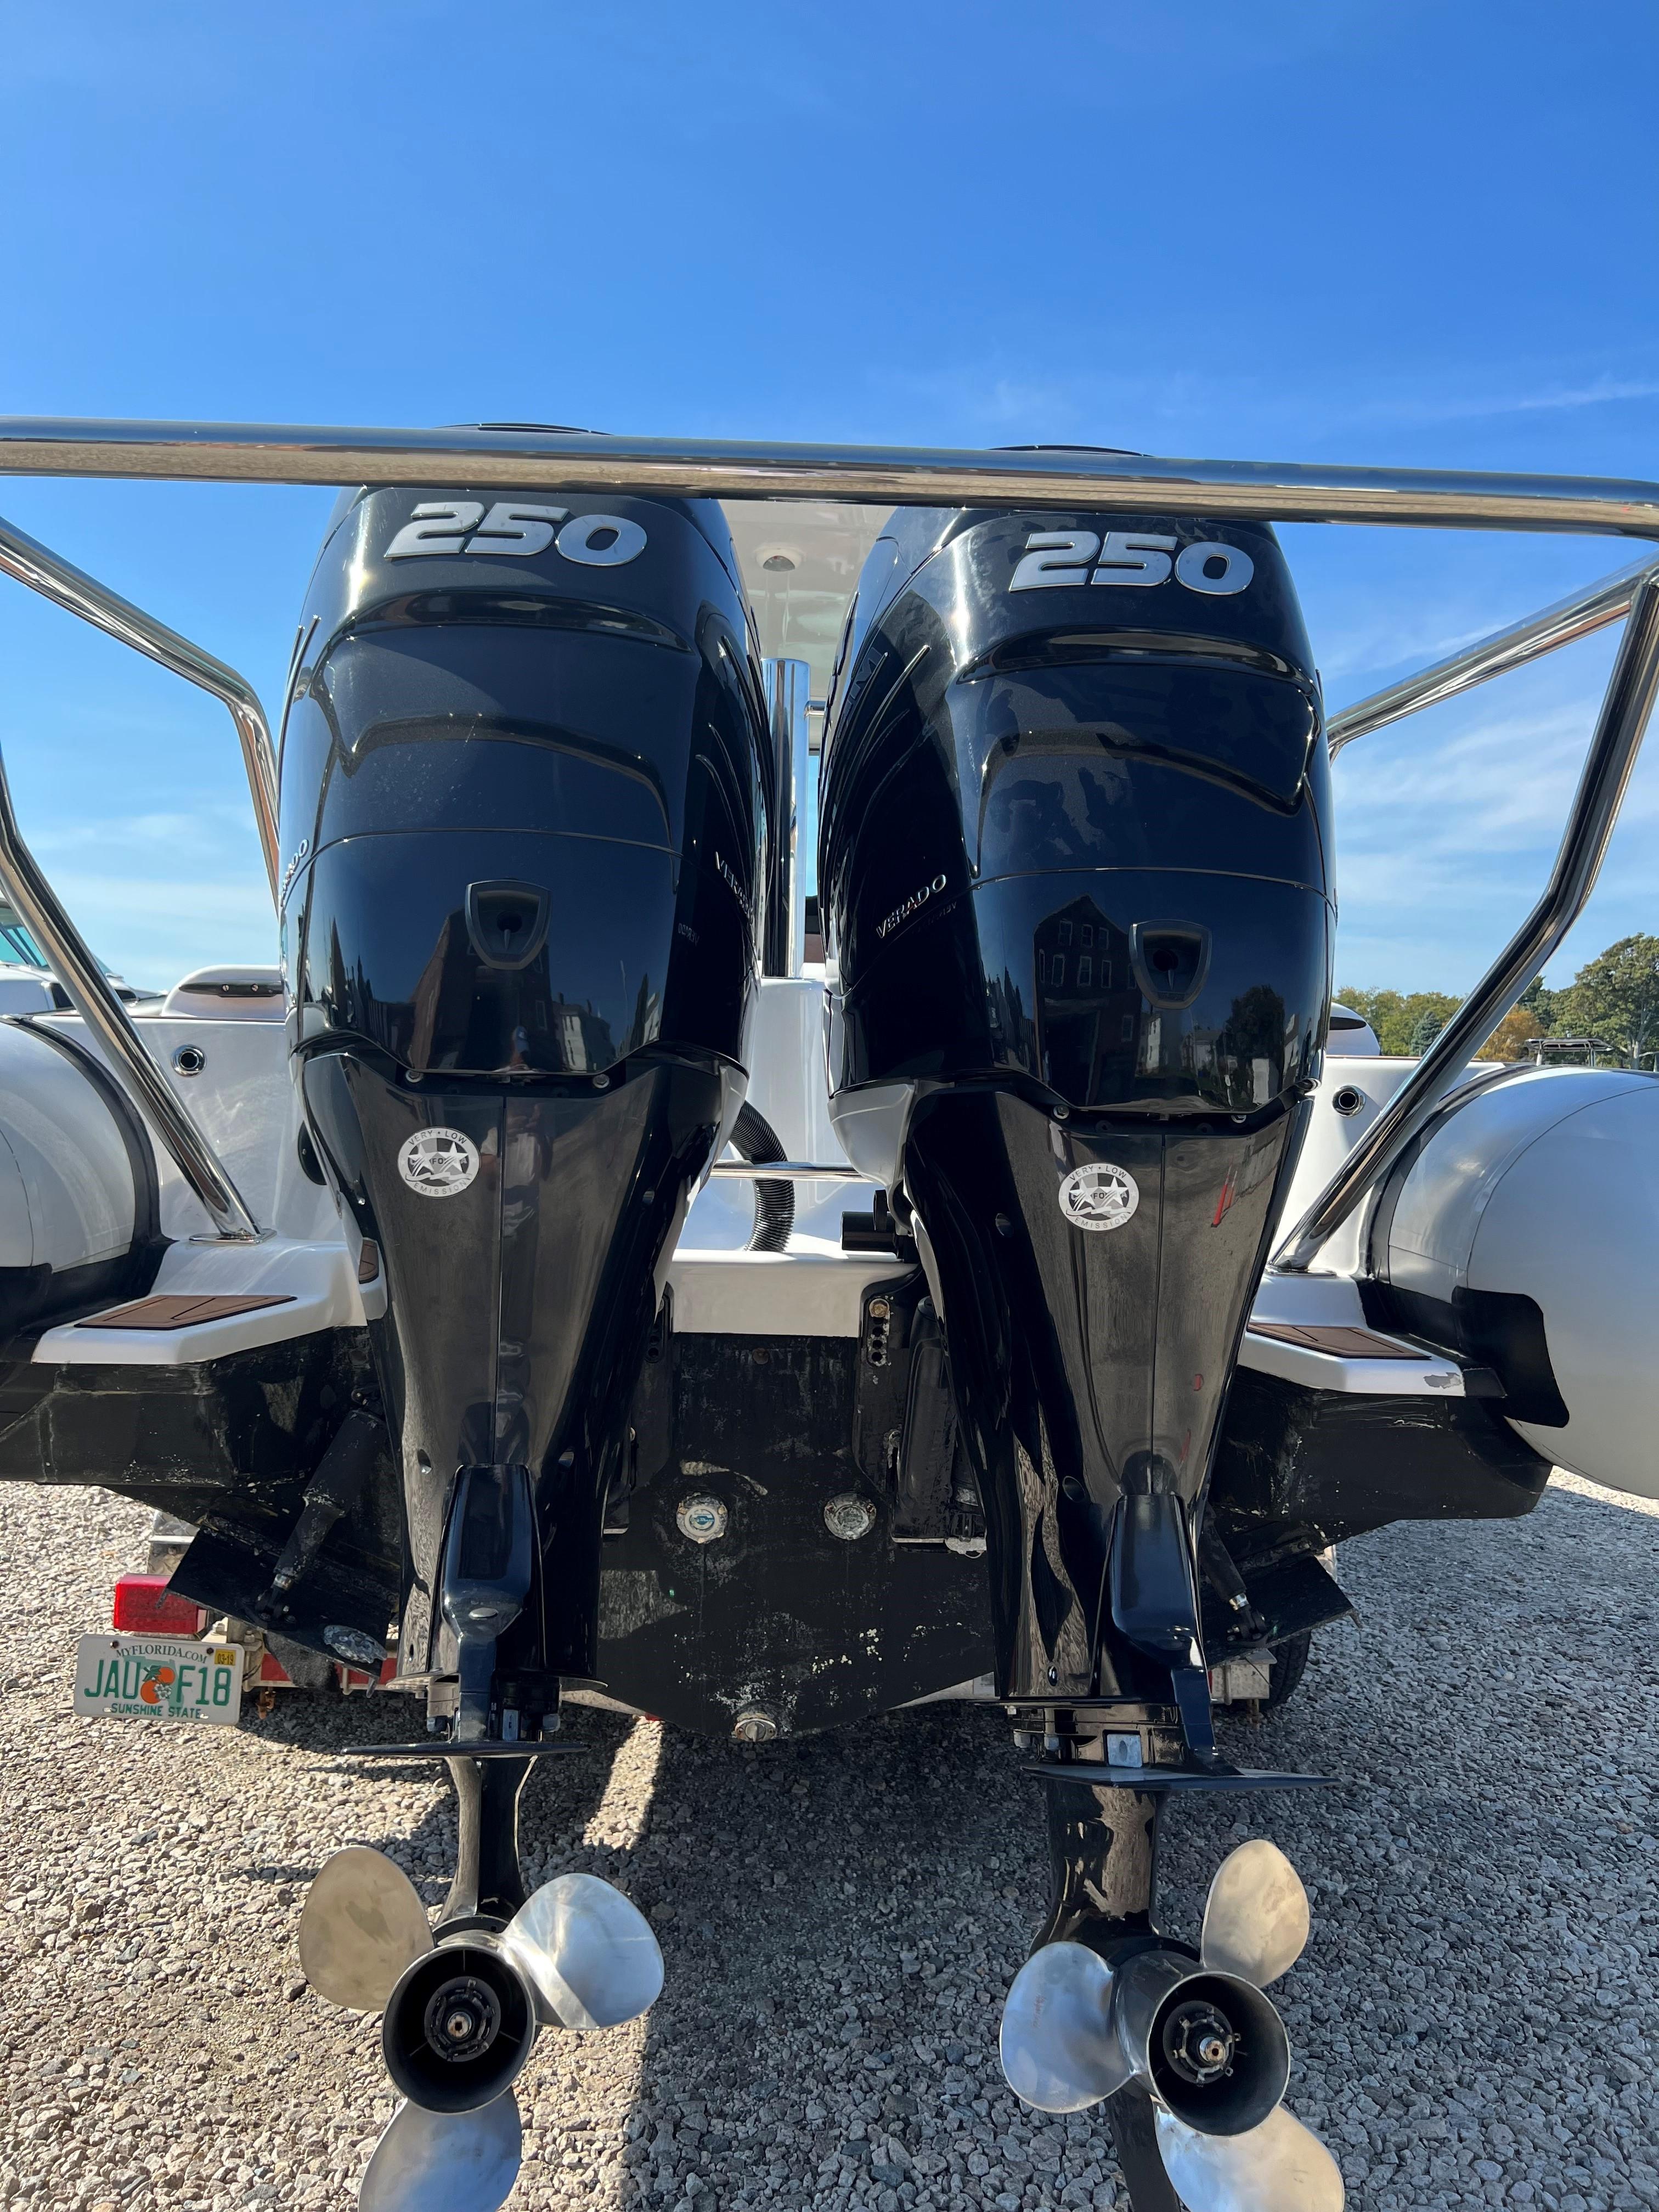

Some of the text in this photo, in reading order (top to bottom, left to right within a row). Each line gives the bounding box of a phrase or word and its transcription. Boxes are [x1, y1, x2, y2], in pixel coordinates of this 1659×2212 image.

[385, 501, 648, 566] 250
[1008, 531, 1255, 595] 250
[876, 874, 947, 939] VERADO
[408, 1130, 467, 1146] VERY LOW
[1070, 1165, 1127, 1181] VERY LOW
[413, 1180, 467, 1195] EMISSION
[1074, 1214, 1127, 1229] EMISSION
[116, 1644, 208, 1664] MYFLORIDA.COM
[84, 1659, 231, 1706] JAU F18
[110, 1702, 202, 1719] SUNSHINE STATE
